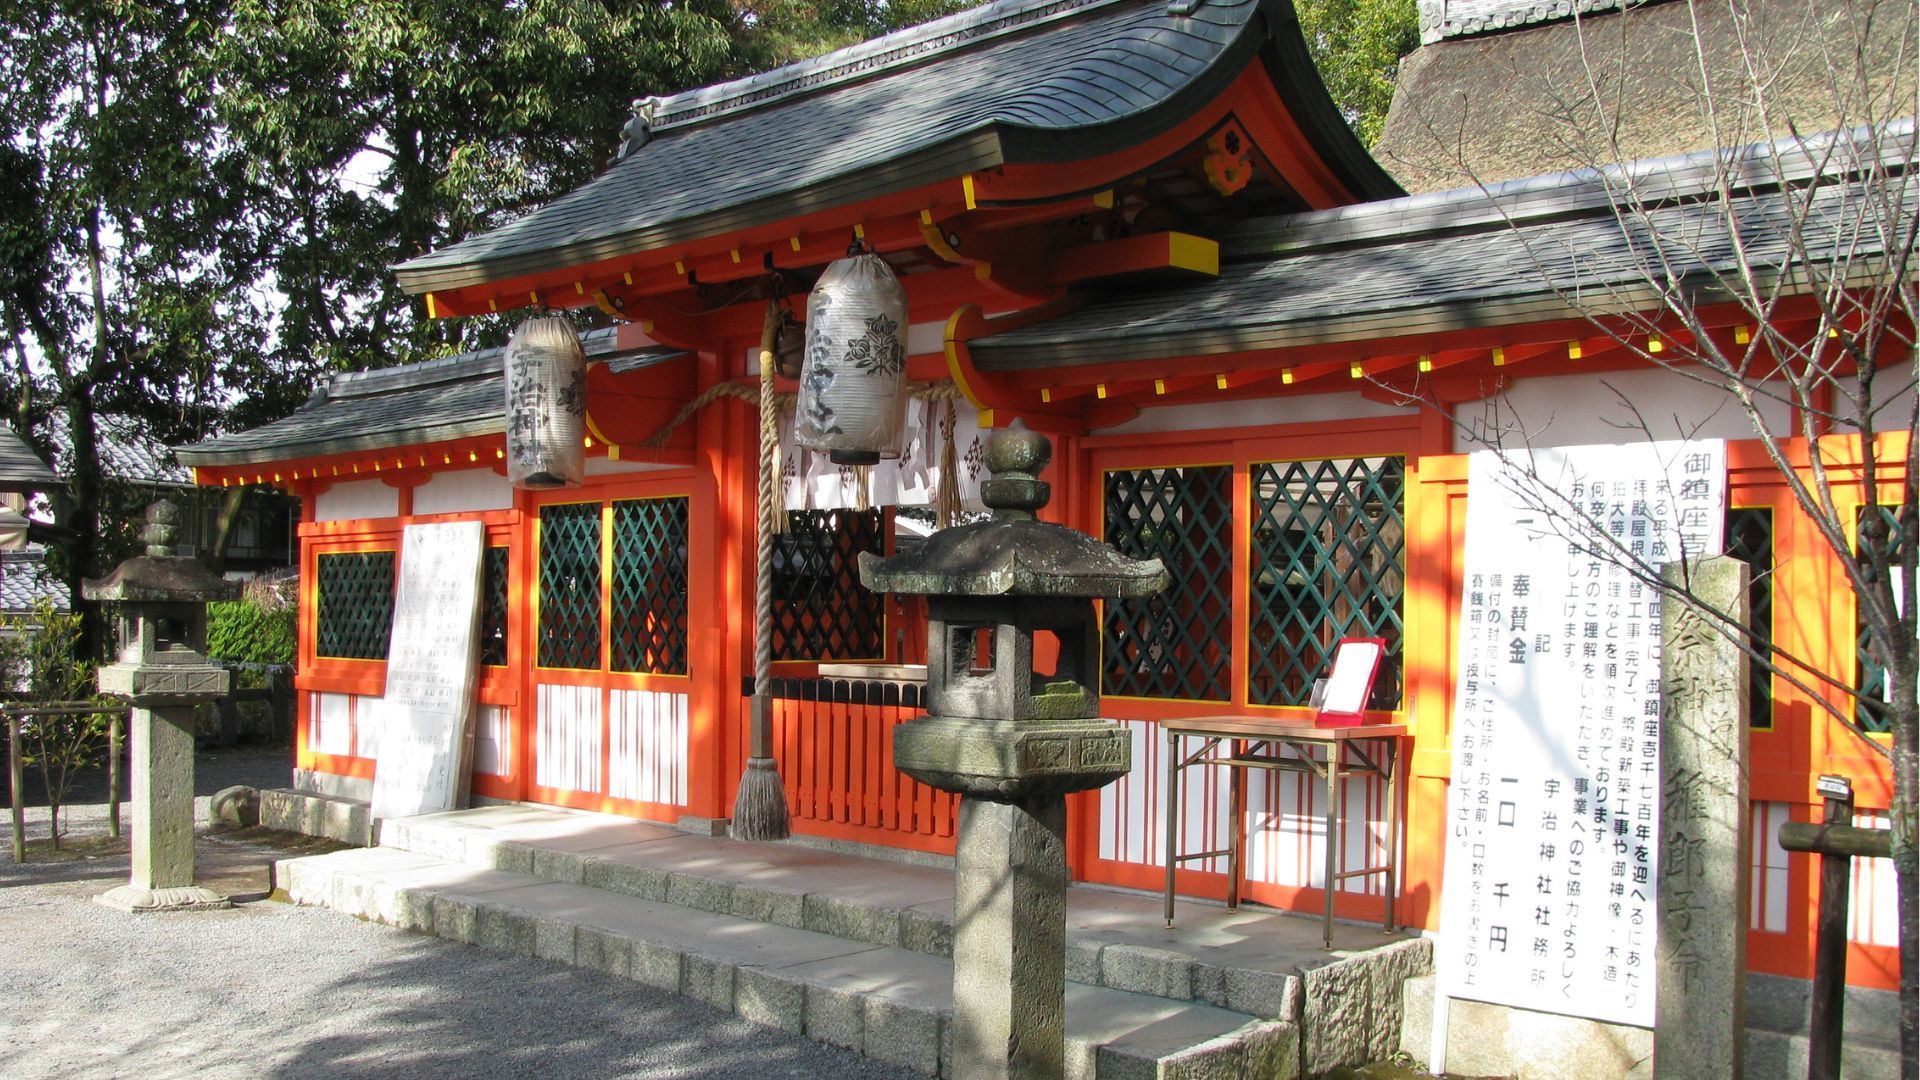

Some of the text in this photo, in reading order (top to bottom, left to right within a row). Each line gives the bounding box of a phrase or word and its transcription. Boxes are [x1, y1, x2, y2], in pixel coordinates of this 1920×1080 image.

[1508, 574, 1531, 665] 奉賛金
[1534, 634, 1551, 654] 記
[1530, 778, 1560, 989] 宇治神社社務所
